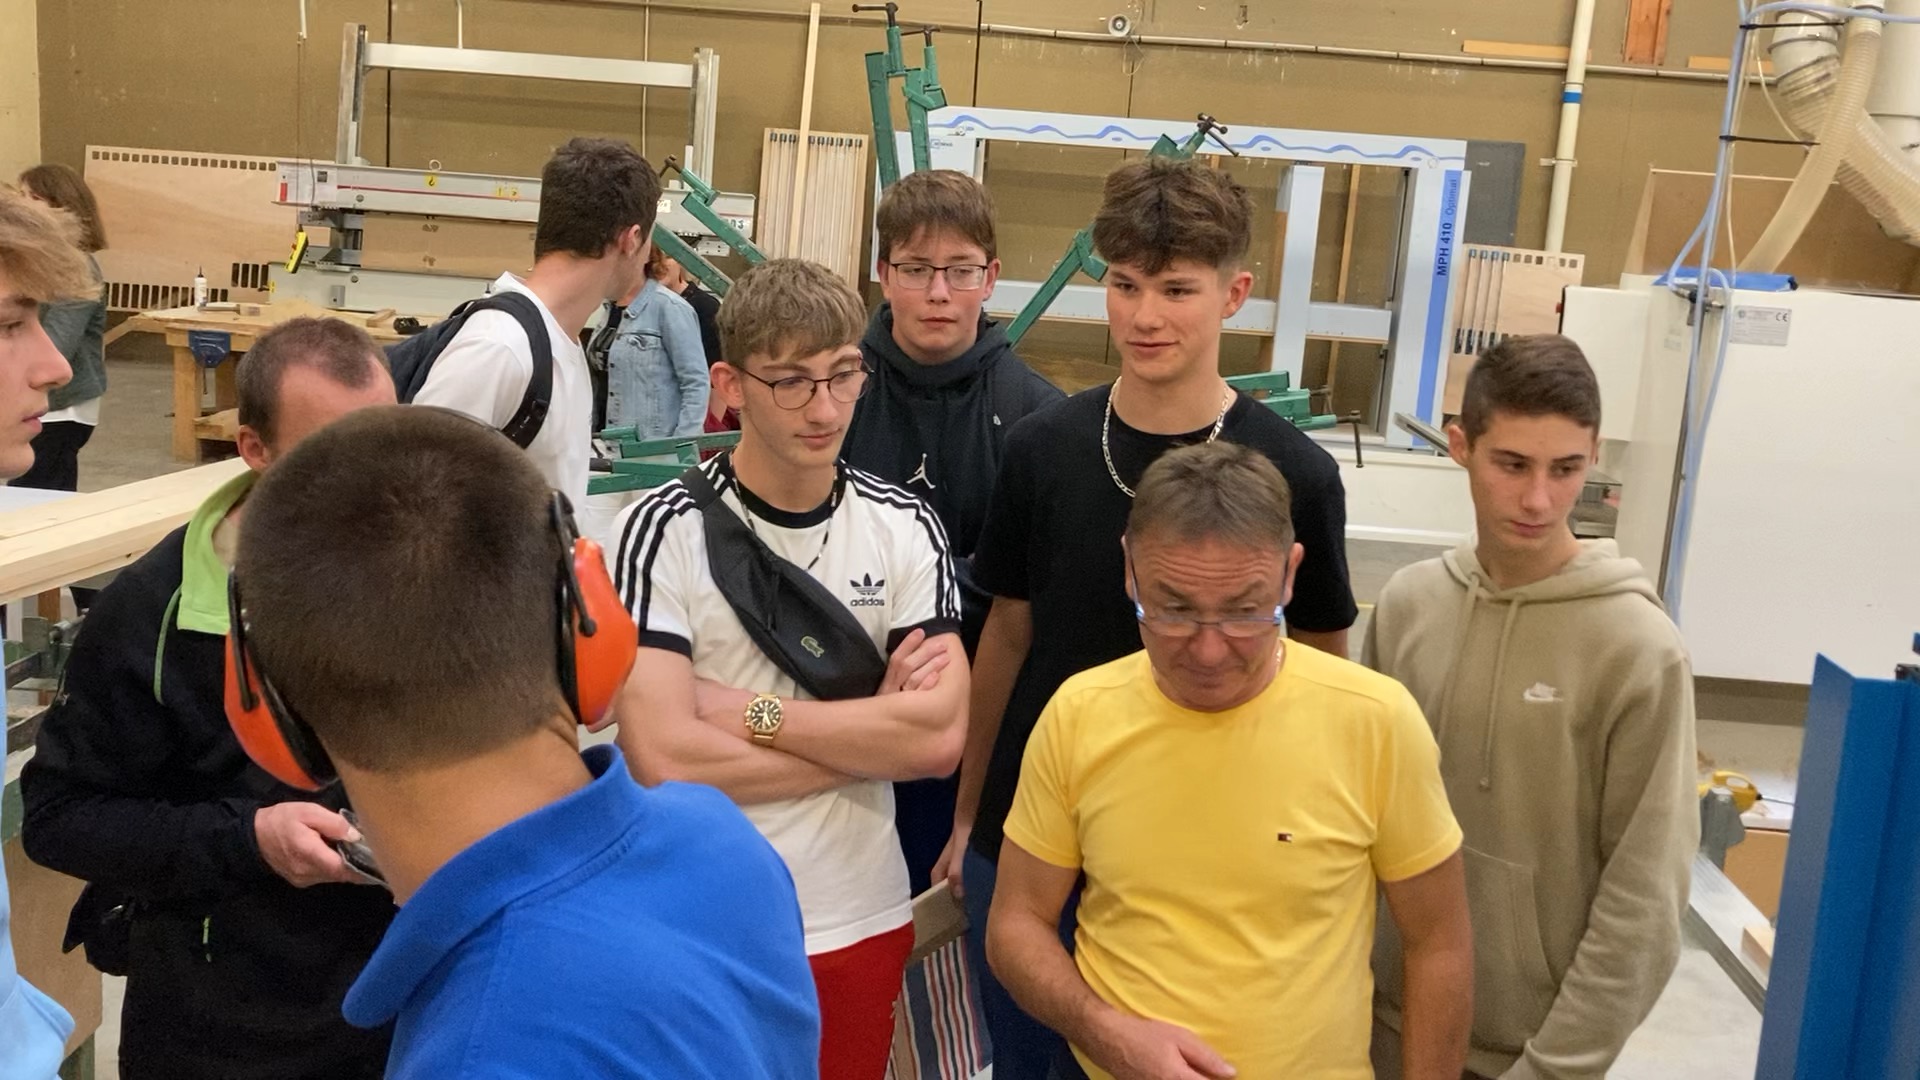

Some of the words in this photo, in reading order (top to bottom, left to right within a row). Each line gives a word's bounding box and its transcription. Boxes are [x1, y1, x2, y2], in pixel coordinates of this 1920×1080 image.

[1445, 179, 1457, 215] Optimal
[1440, 222, 1452, 244] 410
[1437, 247, 1449, 276] MPH
[850, 597, 885, 607] adidas
